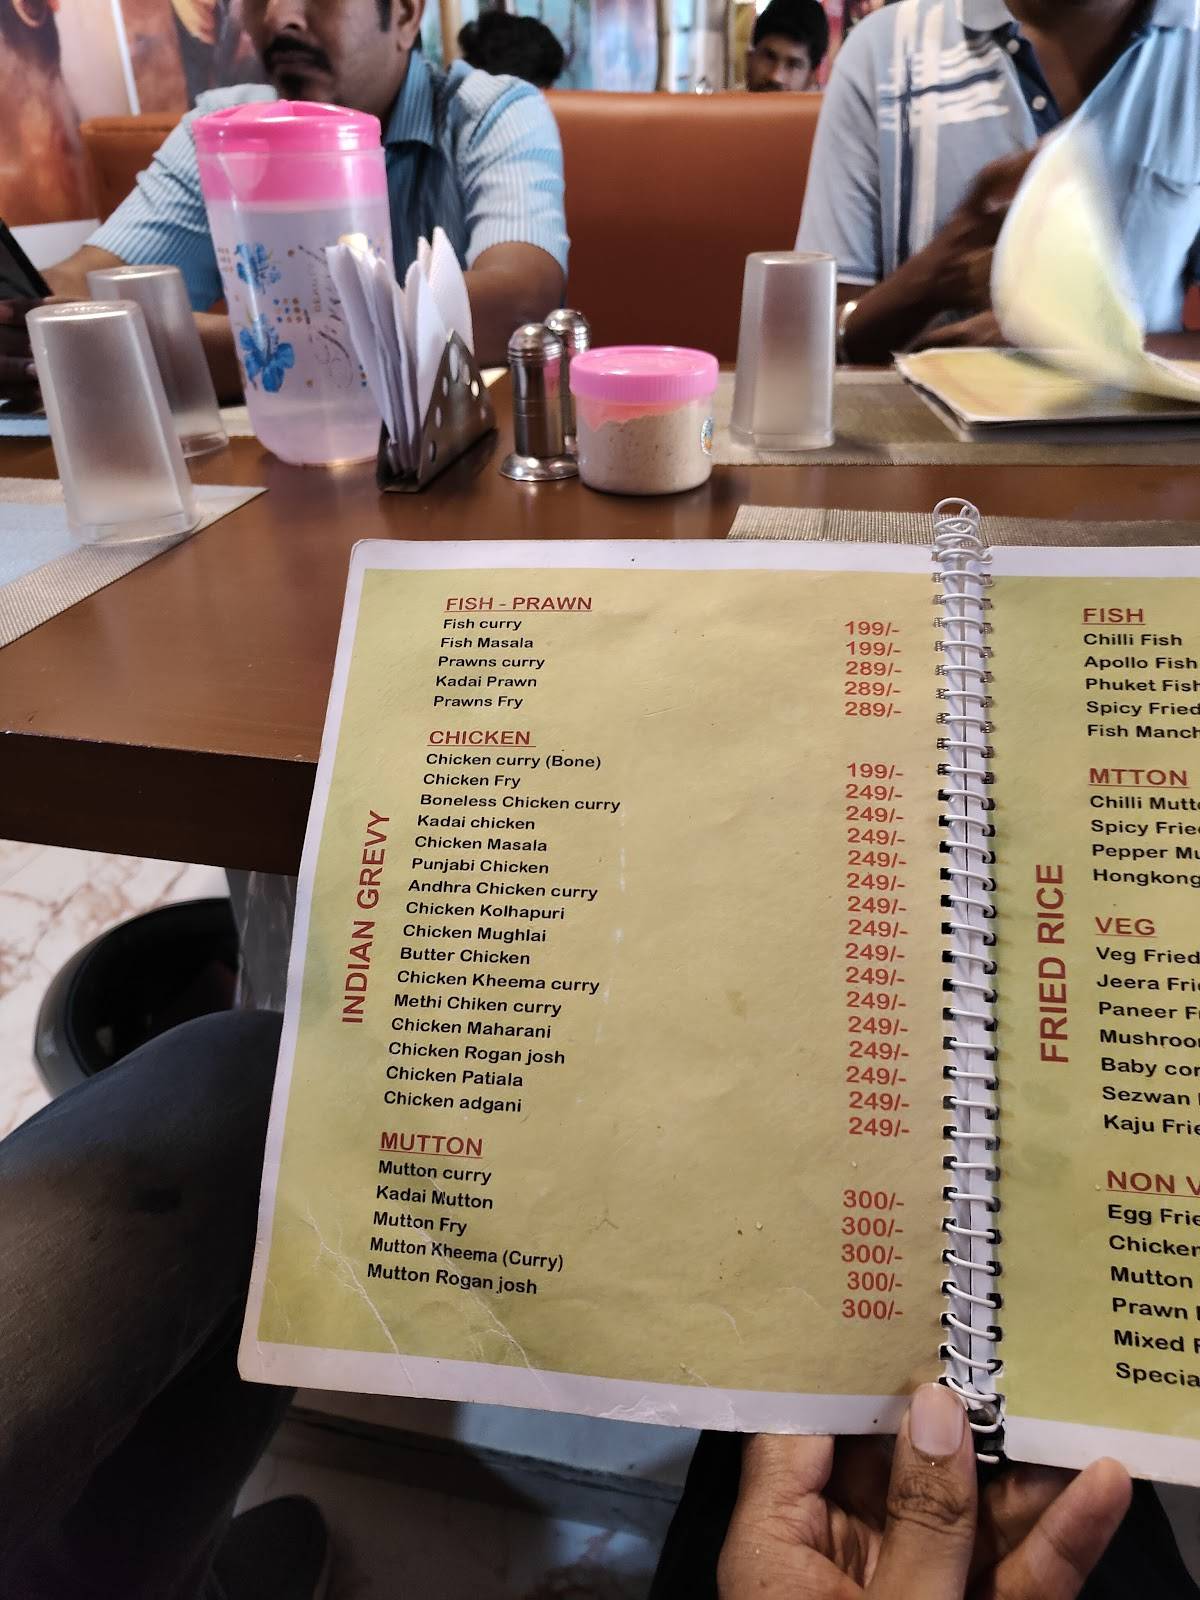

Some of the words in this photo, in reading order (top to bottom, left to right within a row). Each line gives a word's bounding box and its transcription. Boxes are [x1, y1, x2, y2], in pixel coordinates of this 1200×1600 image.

[445, 597, 493, 612] FISH
[512, 597, 591, 611] PRAWN
[444, 619, 474, 629] Fish
[480, 621, 521, 631] curry
[1084, 608, 1143, 623] FISH
[845, 621, 899, 636] 199/-
[441, 638, 472, 647] Fish
[478, 638, 533, 648] Masala
[846, 641, 901, 656] 199/-
[1084, 633, 1133, 645] Chilli
[1141, 634, 1182, 646] Fish
[439, 656, 496, 667] Prawns
[502, 659, 545, 669] curry
[846, 661, 901, 676] 289/-
[1084, 656, 1148, 670] Apollo
[1156, 657, 1197, 669] Fish
[436, 676, 481, 686] Kadai
[487, 676, 536, 687] Prawn
[845, 681, 900, 696] 289/-
[1086, 678, 1156, 691] Phuket
[1162, 680, 1200, 692] Fish
[434, 696, 492, 706] Prawns
[498, 696, 523, 709] Fry
[845, 702, 901, 717] 289/-
[1087, 701, 1142, 717] Spicy
[1149, 703, 1200, 715] Fried
[430, 731, 530, 745] CHICKEN
[1088, 724, 1128, 737] Fish
[427, 754, 491, 765] Chicken
[496, 757, 540, 769] curry
[546, 756, 601, 770] (Bone)
[847, 763, 903, 779] 199/-
[424, 774, 489, 785] Chicken
[495, 775, 520, 789] Fry
[1090, 768, 1187, 786] MTTON
[846, 784, 902, 801] 249/-
[421, 794, 496, 807] Boneless
[503, 796, 569, 809] Chicken
[575, 801, 620, 813] curry
[1090, 795, 1141, 808] Chilli
[1150, 797, 1200, 810] Mutt
[418, 815, 465, 827] Kadai
[471, 817, 535, 829] chicken
[846, 806, 903, 823] 249/-
[848, 828, 905, 846] 249/-
[1091, 820, 1148, 836] Spicy
[1156, 822, 1200, 835] Frie
[415, 836, 481, 849] Chicken
[488, 839, 547, 851] Masala
[1092, 844, 1168, 860] Pepper
[357, 810, 389, 909] GREVY
[412, 858, 474, 873] Punjabi
[480, 860, 548, 874] Chicken
[848, 850, 906, 868] 249/-
[847, 872, 905, 891] 249/-
[1093, 869, 1200, 888] Hongkong
[408, 880, 470, 893] Andhra
[476, 882, 545, 896] Chicken
[551, 888, 598, 901] curry
[406, 902, 474, 915] Chicken
[480, 904, 564, 921] Kolhapuri
[848, 896, 906, 914] 249/-
[1036, 865, 1064, 944] RICE
[404, 925, 472, 938] Chicken
[478, 927, 546, 943] Mughlai
[849, 919, 908, 938] 249/-
[1095, 917, 1155, 937] VEG
[401, 947, 455, 961] Butter
[460, 950, 529, 964] Chicken
[846, 943, 904, 962] 249/-
[1096, 947, 1136, 964] Veg
[1144, 949, 1200, 964] Fried
[342, 921, 375, 1023] INDIAN
[846, 966, 904, 986] 249/-
[398, 970, 466, 985] Chicken
[473, 974, 545, 989] Kheema
[551, 981, 599, 995] curry
[1097, 974, 1159, 990] Jeera
[1167, 978, 1200, 992] Fri
[395, 994, 441, 1008] Methi
[448, 997, 507, 1011] Chiken
[514, 1003, 561, 1017] curry
[847, 991, 906, 1010] 249/-
[1039, 957, 1068, 1062] FRIED
[1099, 1002, 1177, 1018] Paneer
[392, 1018, 461, 1033] Chicken
[467, 1022, 551, 1038] Maharani
[848, 1016, 908, 1035] 249/-
[1100, 1029, 1200, 1048] Mushroo
[389, 1042, 459, 1058] Chicken
[465, 1046, 521, 1063] Rogan
[525, 1049, 564, 1065] josh
[849, 1041, 909, 1060] 249/-
[387, 1066, 456, 1082] Chicken
[463, 1070, 522, 1086] Patiala
[846, 1066, 906, 1086] 249/-
[1101, 1057, 1157, 1077] Baby
[384, 1091, 453, 1108] Chicken
[460, 1096, 521, 1113] adgani
[849, 1091, 909, 1111] 249/-
[1103, 1086, 1190, 1105] Sezwan
[849, 1117, 909, 1137] 249/-
[1104, 1115, 1154, 1134] Kaju
[379, 1132, 482, 1157] MUTTON
[379, 1160, 437, 1178] Mutton
[443, 1169, 491, 1185] curry
[1107, 1170, 1175, 1193] NON
[377, 1185, 426, 1203] Kadai
[432, 1190, 492, 1209] Mutton
[843, 1190, 904, 1210] 300/-
[374, 1211, 434, 1230] Mutton
[440, 1217, 467, 1236] Fry
[1108, 1204, 1152, 1225] Egg
[842, 1217, 903, 1237] 300/-
[370, 1237, 426, 1255] Mutton
[432, 1242, 497, 1263] Kheema
[503, 1250, 563, 1272] (Curry)
[841, 1243, 902, 1264] 300/-
[368, 1263, 429, 1282] Mutton
[436, 1270, 493, 1290] Rogan
[496, 1276, 536, 1294] josh
[848, 1271, 902, 1292] 300/-
[1111, 1266, 1192, 1288] Mutton
[842, 1299, 903, 1320] 300/-
[1113, 1297, 1188, 1320] Prawn
[1114, 1330, 1184, 1352] Mixed
[1116, 1362, 1200, 1387] Specia
